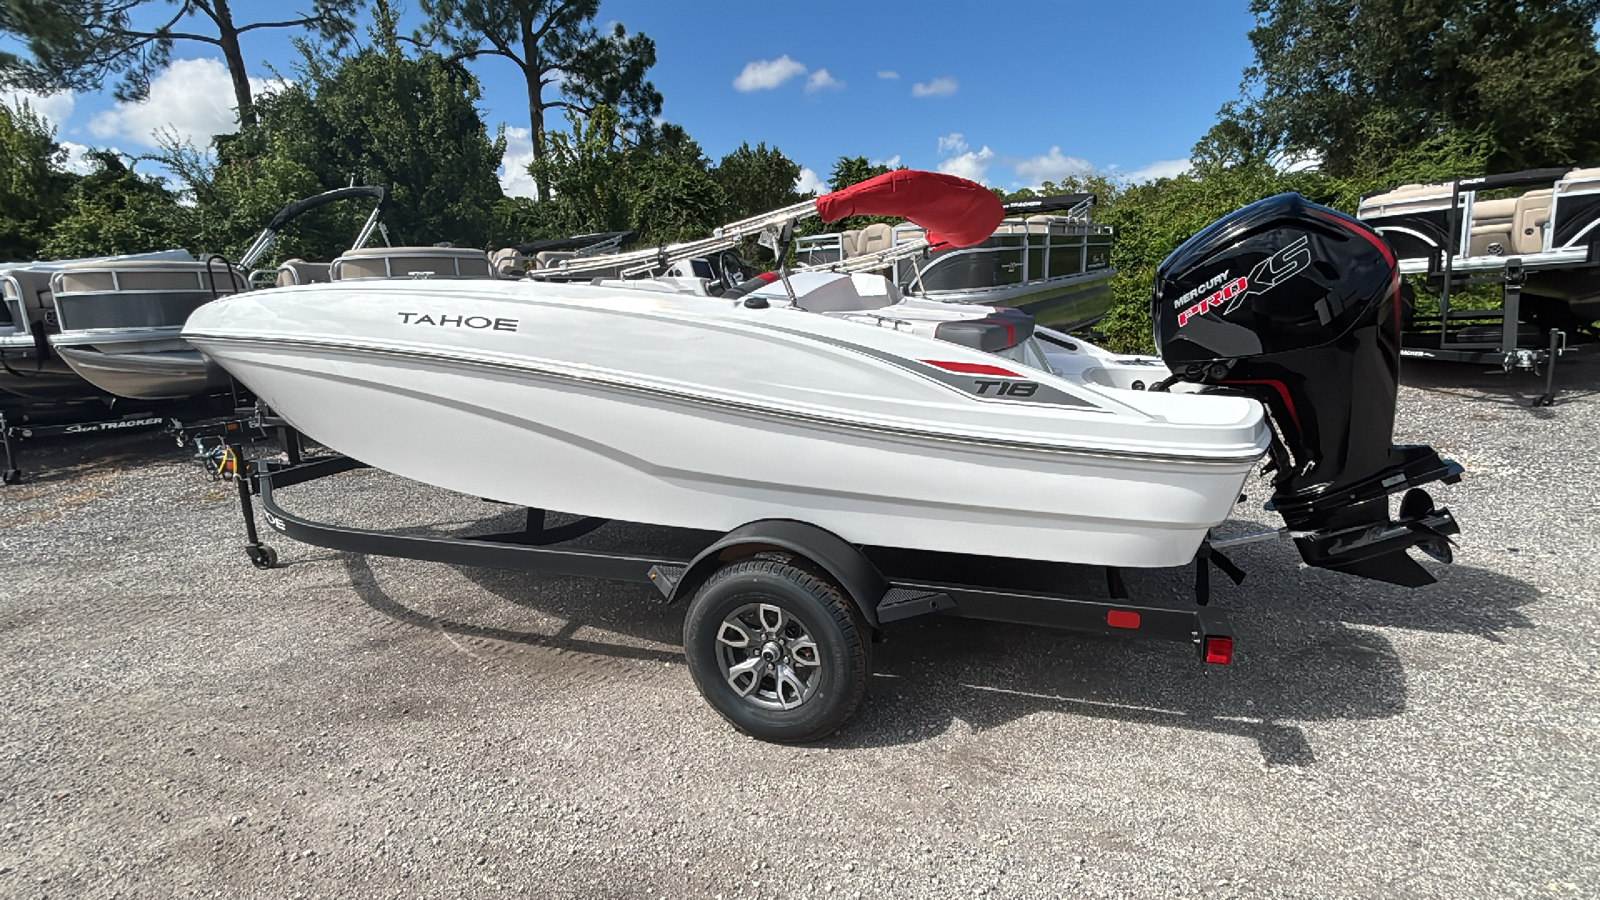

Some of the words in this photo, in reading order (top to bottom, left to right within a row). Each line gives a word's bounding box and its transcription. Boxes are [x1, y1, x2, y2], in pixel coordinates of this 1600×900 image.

[1174, 269, 1230, 309] MERCURY
[1177, 276, 1249, 328] PRO
[397, 312, 519, 332] TAHOE
[974, 380, 1039, 397] T18
[100, 417, 163, 430] TRACKER
